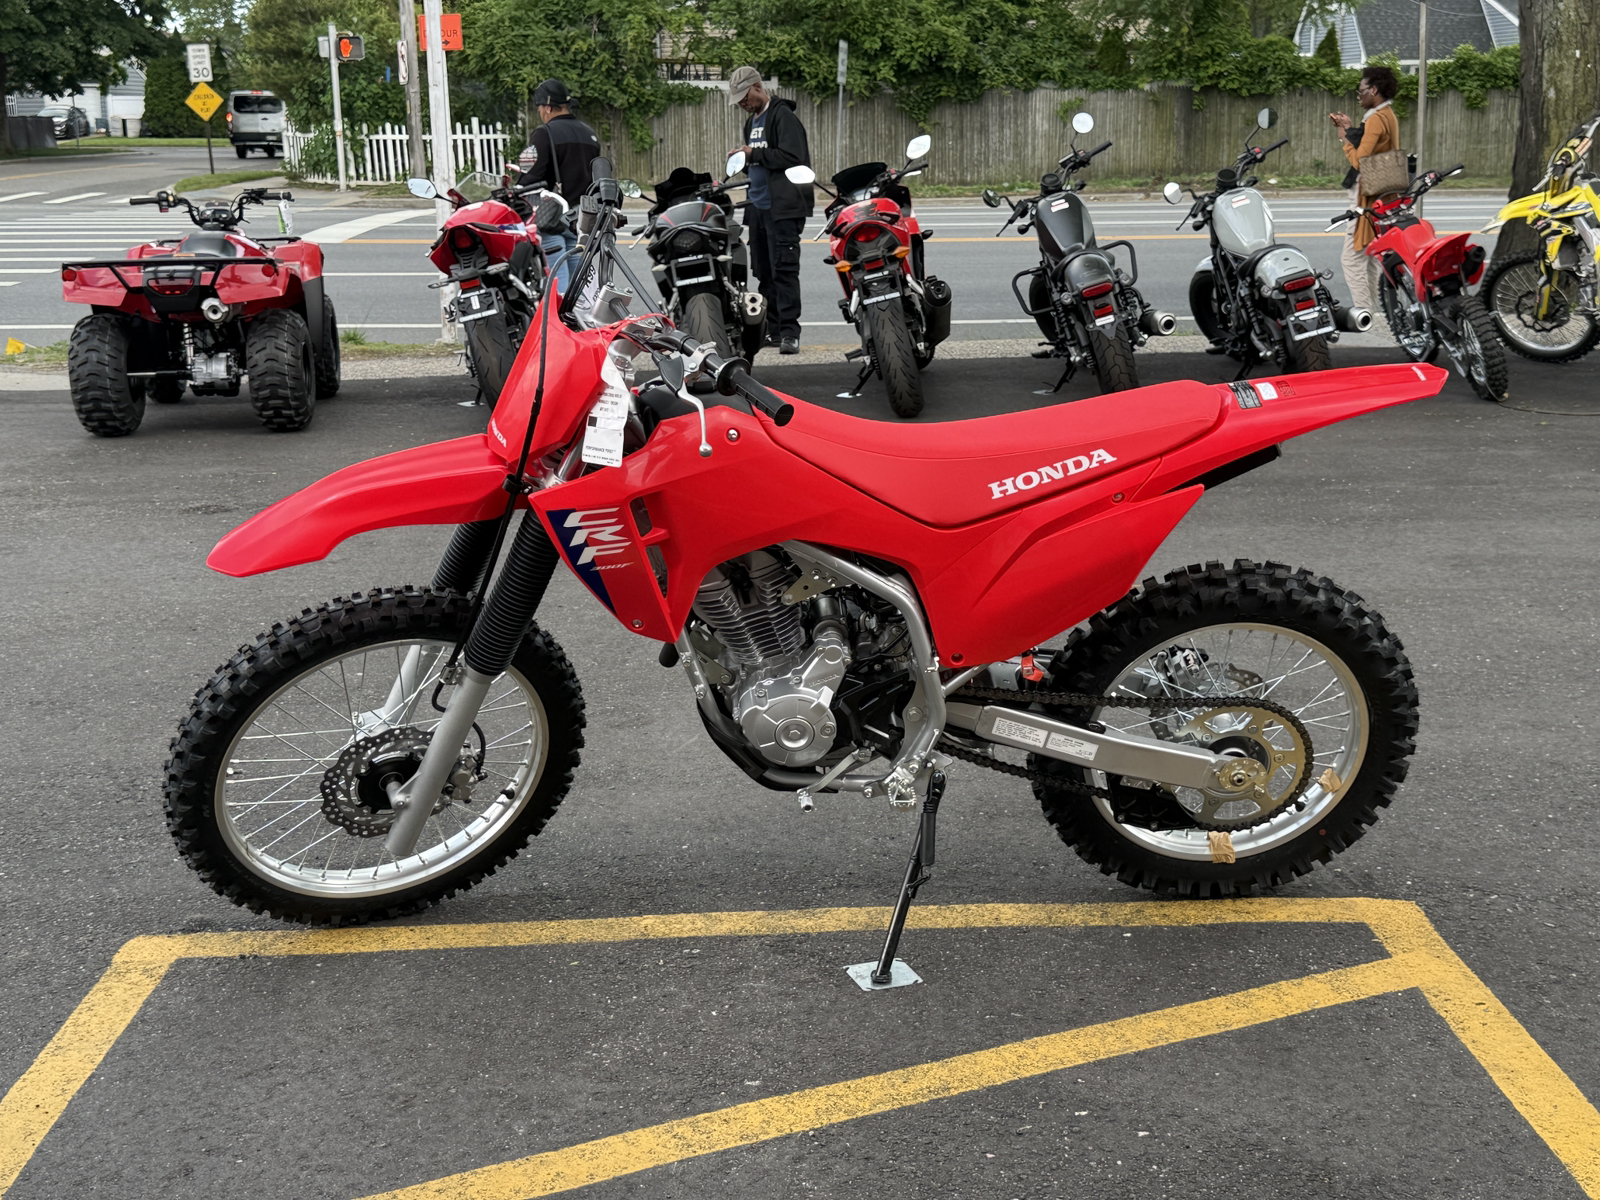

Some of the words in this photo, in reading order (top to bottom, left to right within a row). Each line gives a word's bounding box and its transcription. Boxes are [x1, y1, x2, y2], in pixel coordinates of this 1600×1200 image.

[193, 67, 210, 78] 30
[987, 448, 1118, 499] HONDA
[562, 506, 632, 566] CRF
